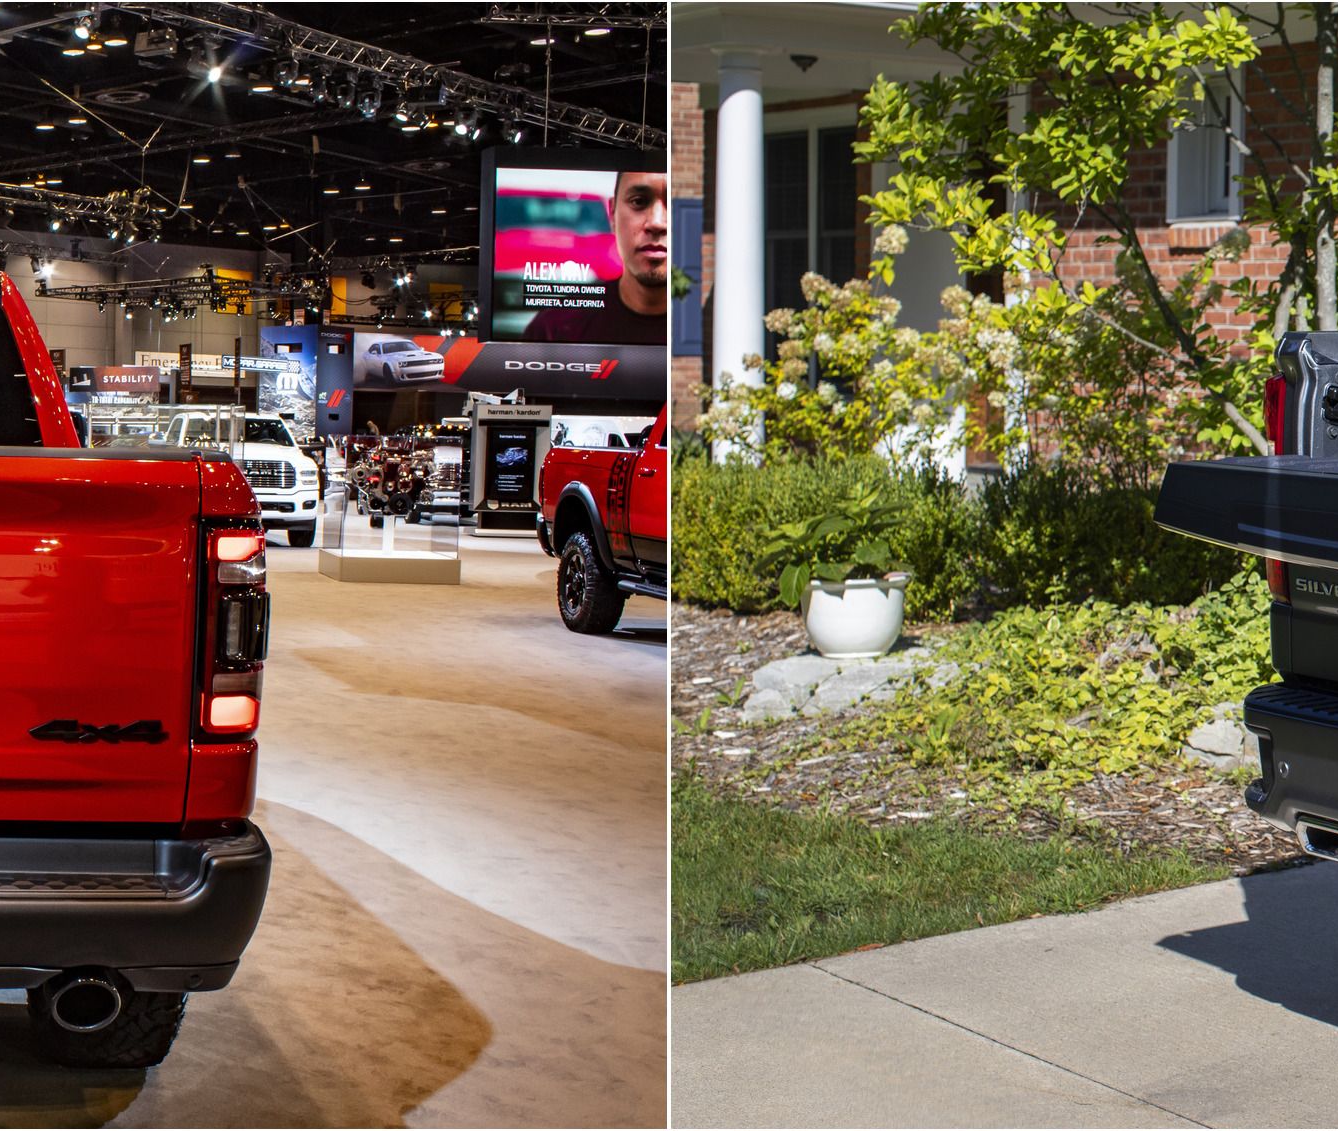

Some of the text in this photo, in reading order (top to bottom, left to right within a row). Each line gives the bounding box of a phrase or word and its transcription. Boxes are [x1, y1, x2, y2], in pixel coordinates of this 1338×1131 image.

[523, 261, 557, 280] ALEX
[526, 284, 605, 295] TOYOTA TUNDRA OWNER
[525, 298, 605, 308] MURRIETA, CALIFORNIA
[504, 360, 603, 373] DODGE
[102, 375, 154, 383] STABILITY
